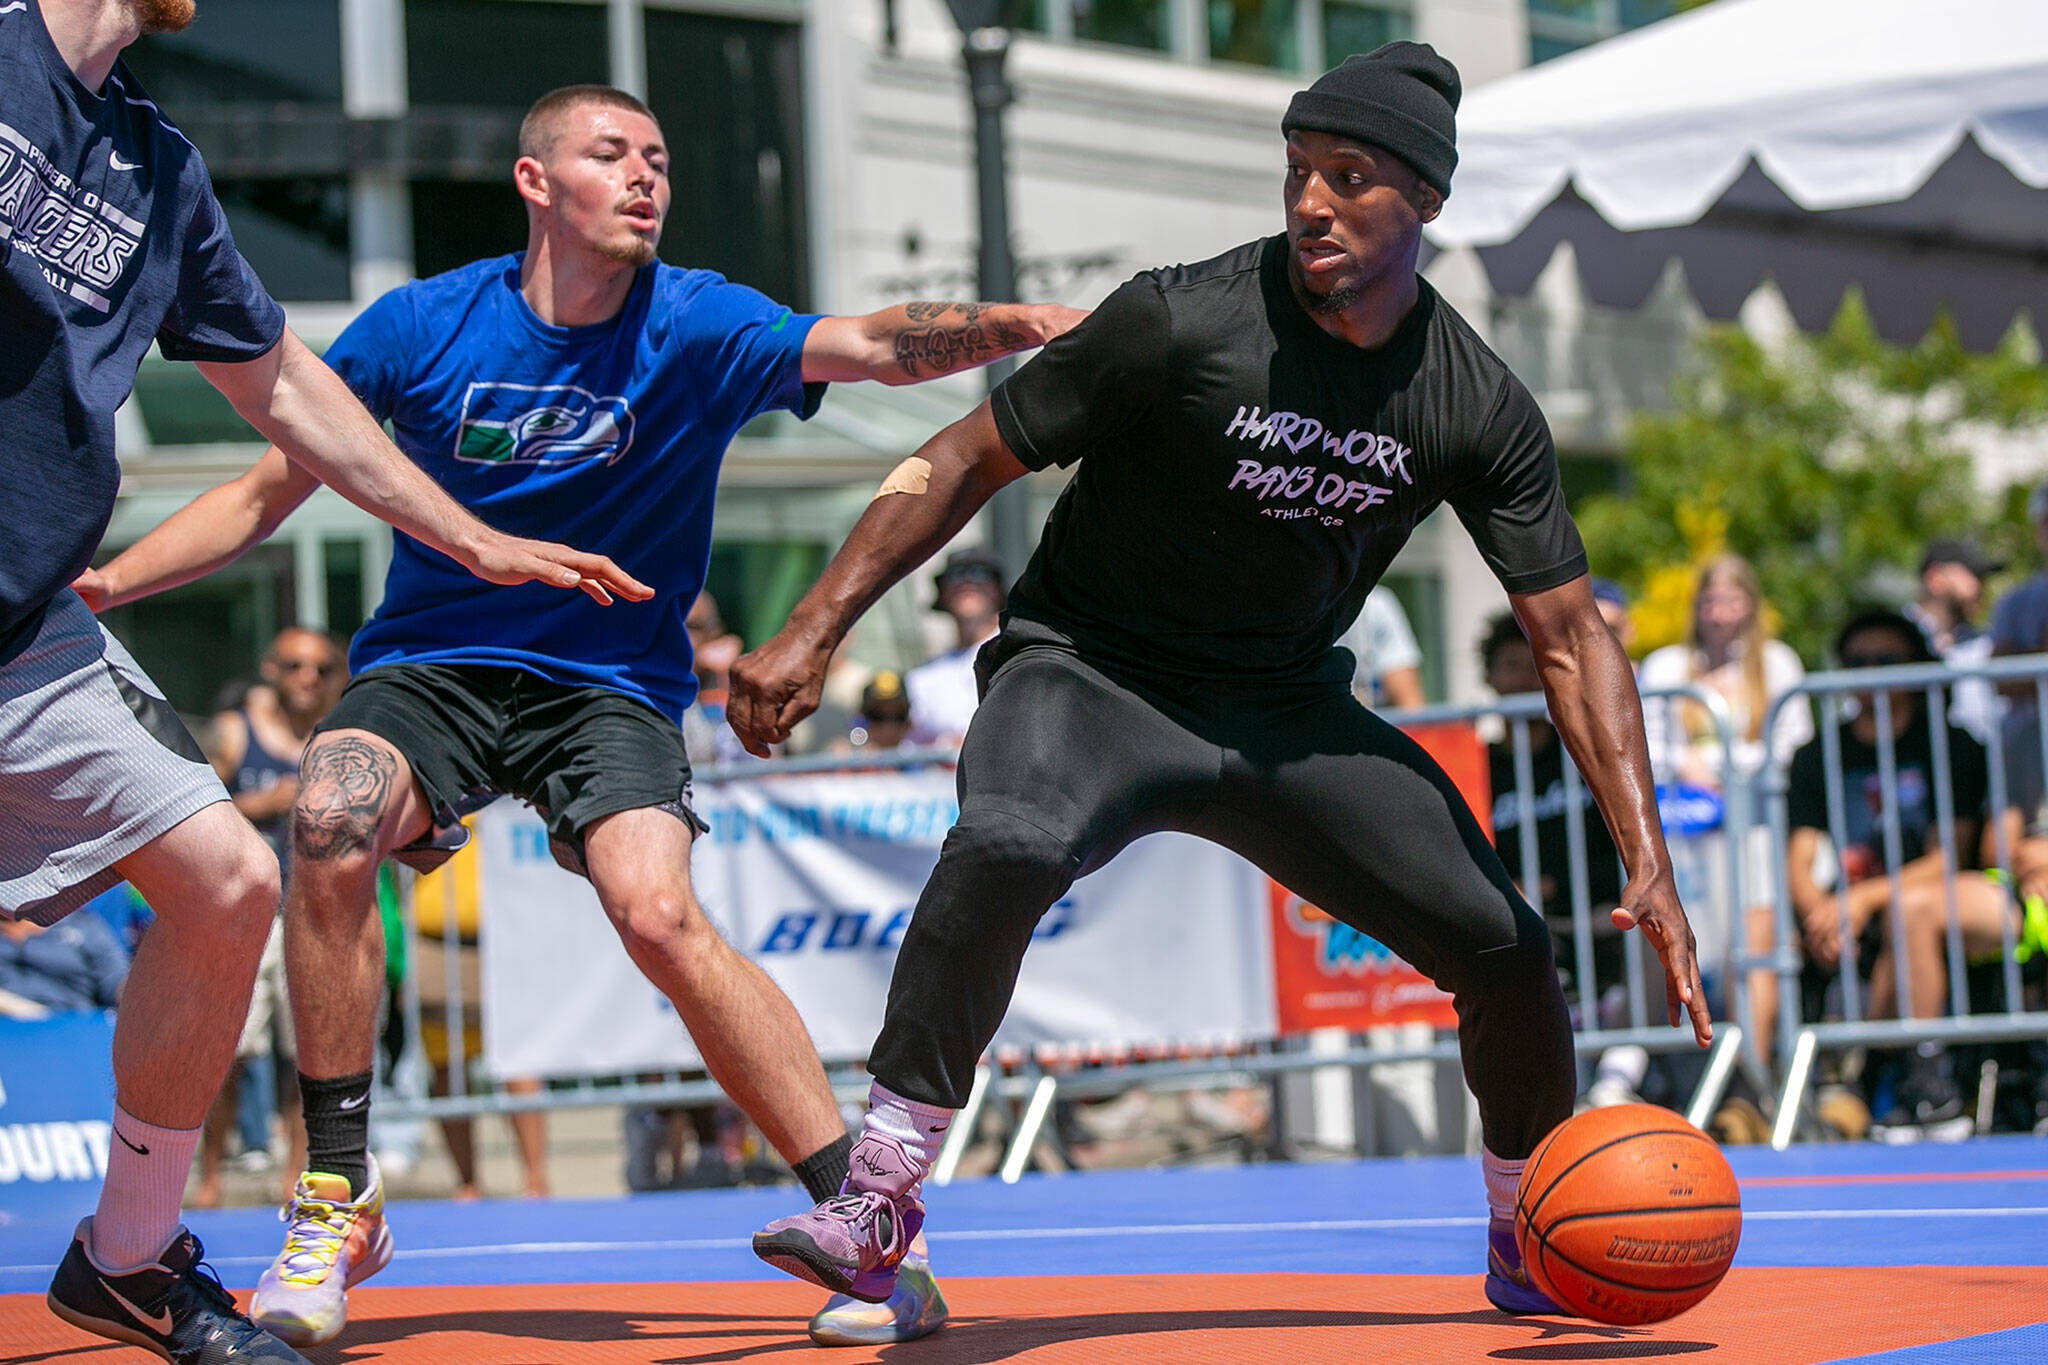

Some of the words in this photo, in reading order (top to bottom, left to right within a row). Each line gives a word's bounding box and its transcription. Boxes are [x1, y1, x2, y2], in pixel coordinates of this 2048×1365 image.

[29, 144, 82, 199] PRPERY
[83, 191, 103, 211] O
[1225, 405, 1323, 455] HARD
[1322, 428, 1413, 485] WORK
[1228, 459, 1317, 501] PAYS
[1315, 473, 1393, 514] OFF
[1260, 506, 1345, 526] ATHLECS
[761, 901, 1074, 952] BOEG
